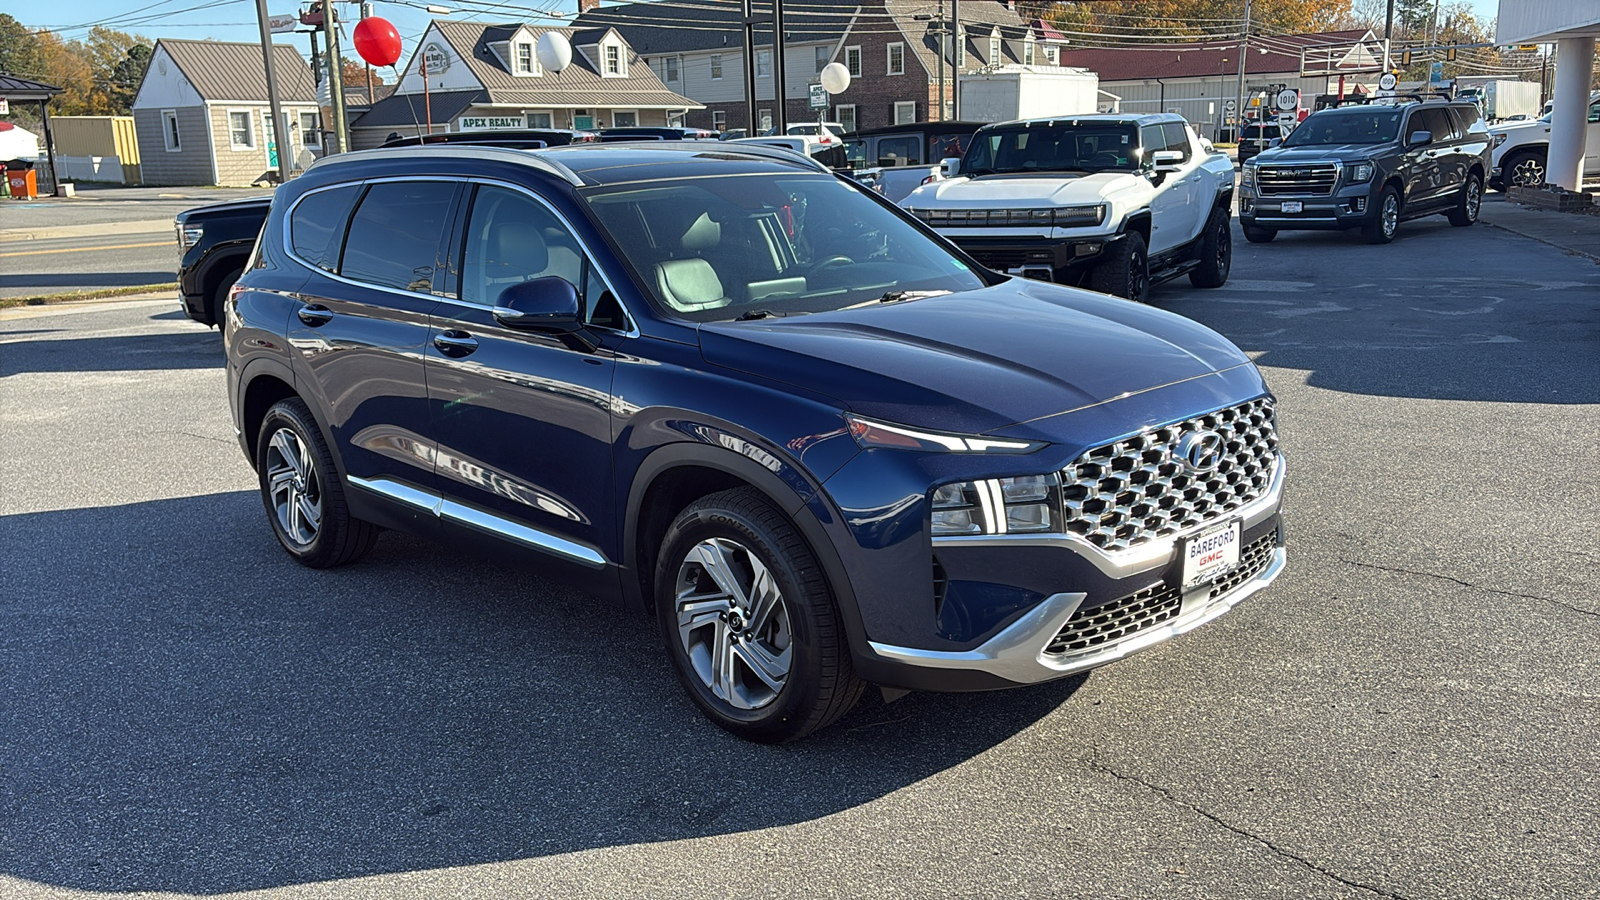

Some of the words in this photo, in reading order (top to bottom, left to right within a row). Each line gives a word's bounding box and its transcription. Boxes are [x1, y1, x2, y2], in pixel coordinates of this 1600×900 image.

[1280, 95, 1295, 104] 1010
[463, 118, 486, 127] APEX
[489, 118, 521, 127] REALTY
[1190, 529, 1235, 558] BAREFORD
[1199, 550, 1223, 566] GMC
